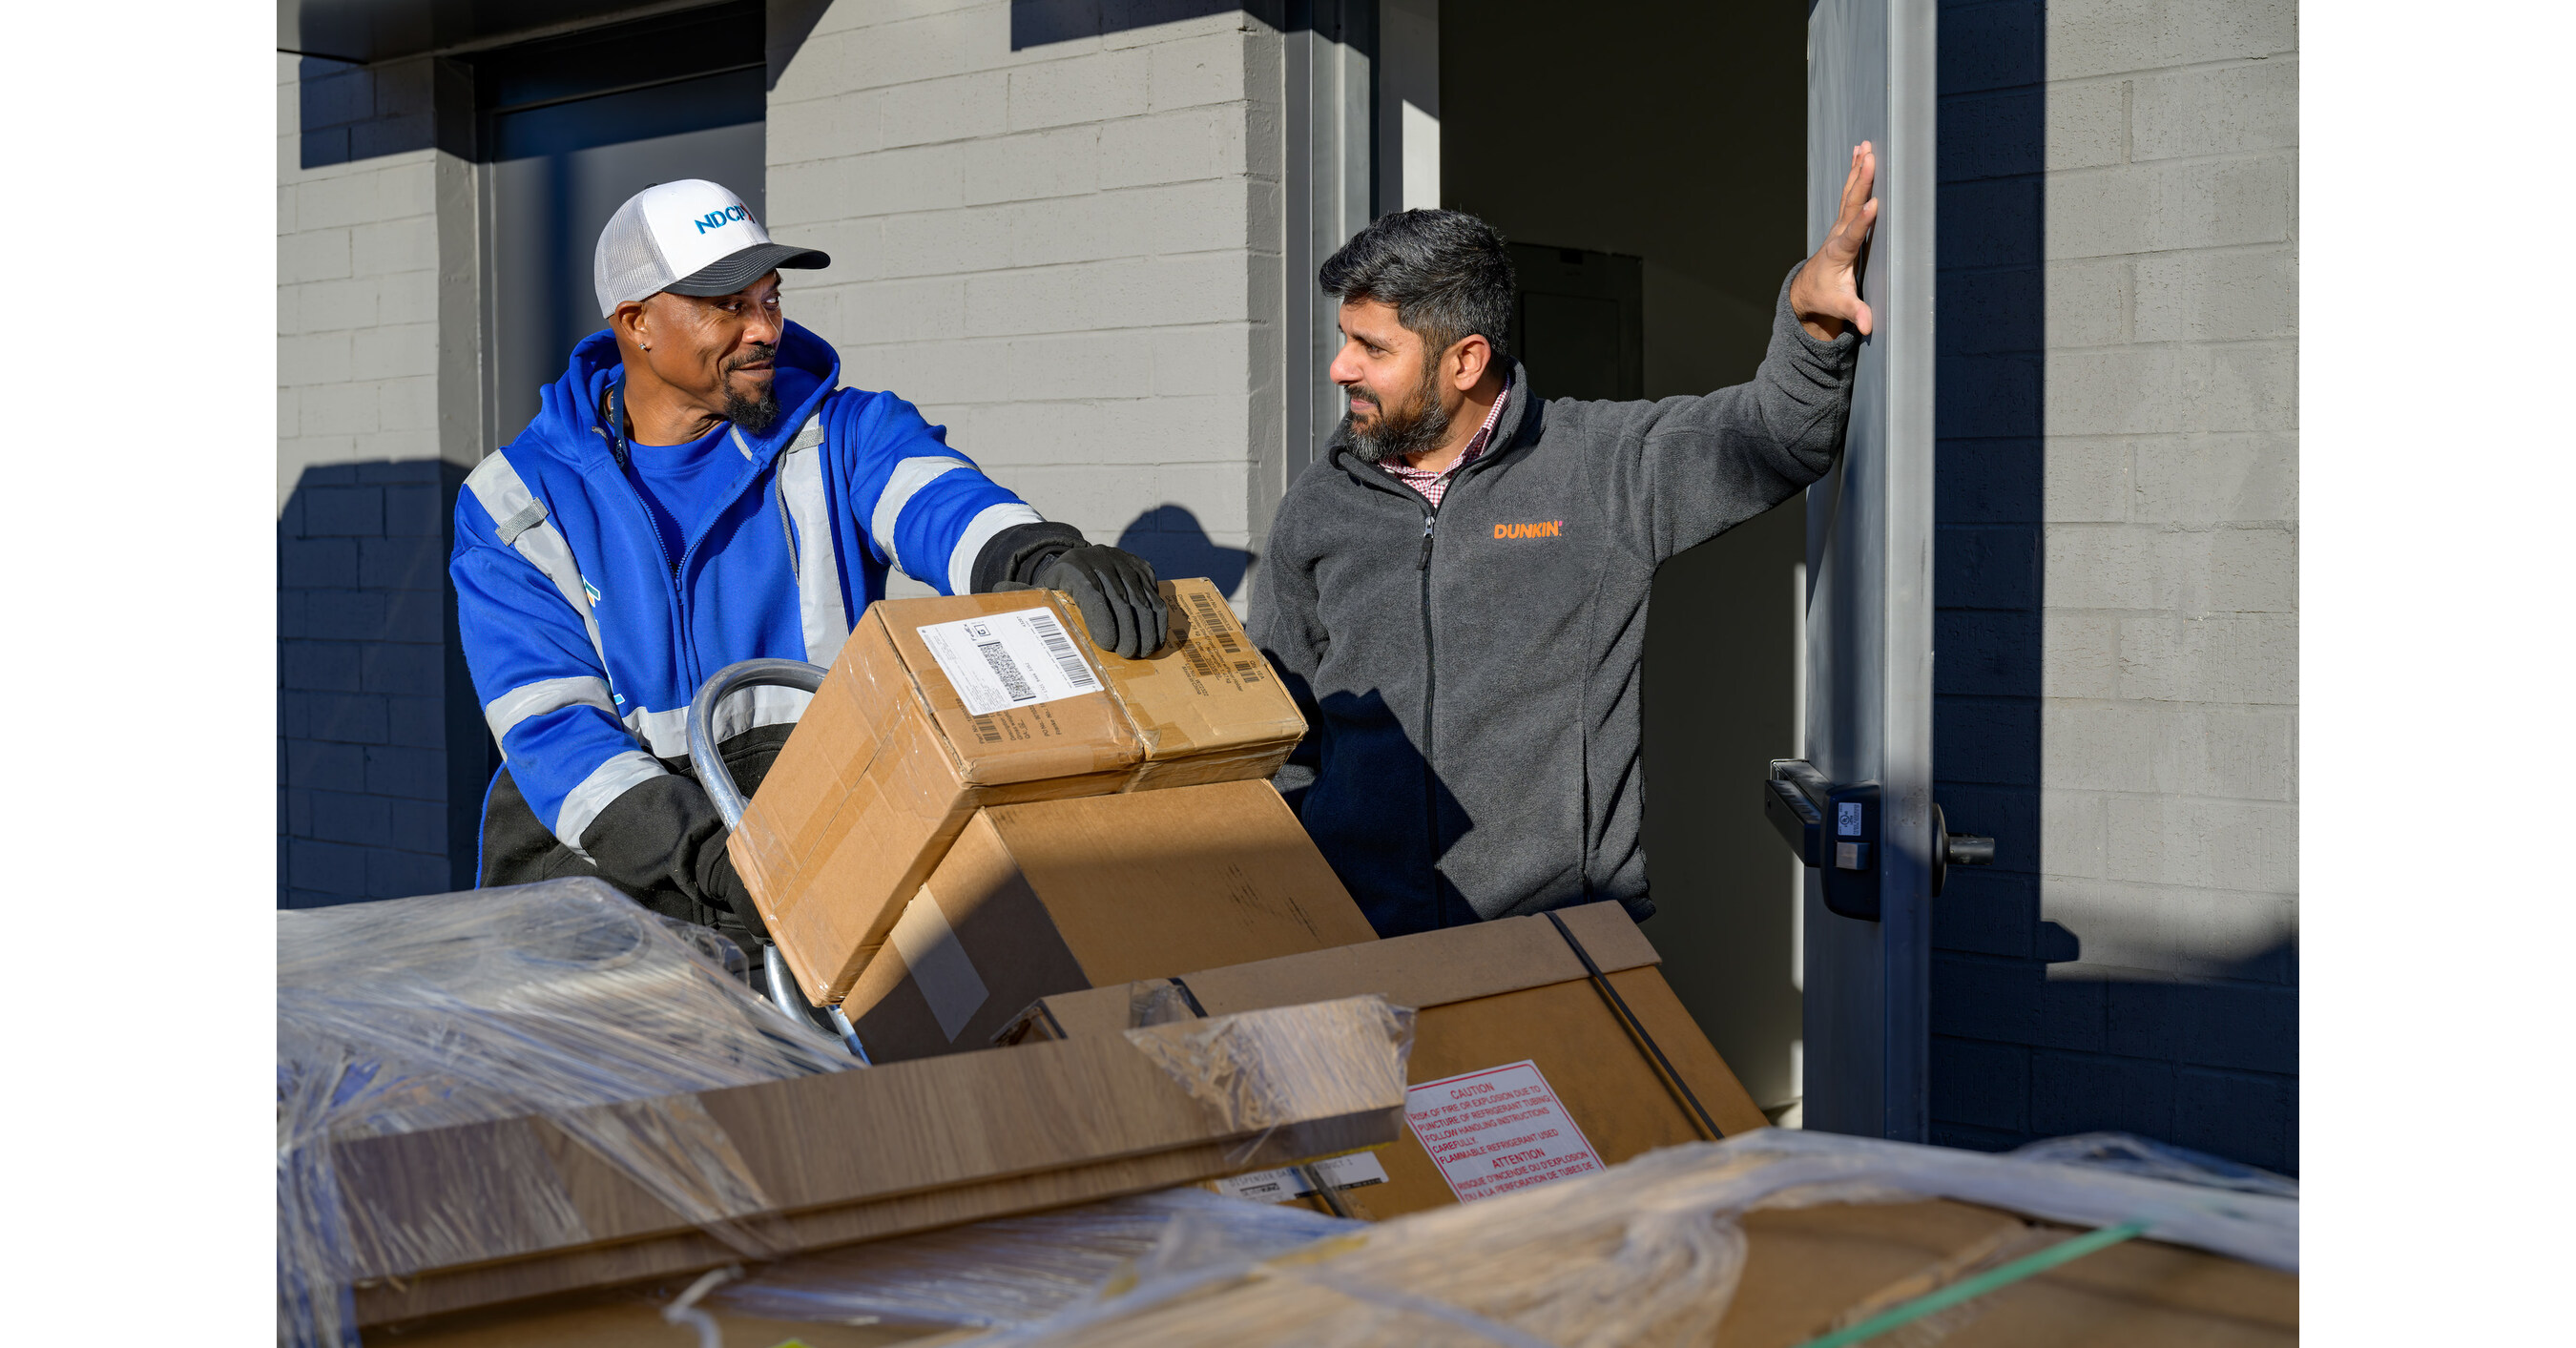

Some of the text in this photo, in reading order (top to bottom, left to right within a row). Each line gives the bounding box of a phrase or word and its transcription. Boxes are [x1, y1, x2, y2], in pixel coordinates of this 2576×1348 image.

[1410, 1086, 1541, 1121] RISK OF FIRE OR EXPLOSION DUE TO
[1450, 1083, 1495, 1099] CAUTION
[1417, 1116, 1461, 1132] PUNCTURE
[1461, 1112, 1471, 1123] OF
[1472, 1101, 1522, 1120] REFRIGERANT
[1423, 1107, 1550, 1144] FOLLOW HANDLING INSTRUCTIONS
[1432, 1136, 1478, 1153] CAREFULLY.
[1439, 1129, 1559, 1165] FLAMMABLE REFRIGERANT USED
[1492, 1148, 1546, 1169] ATTENTION
[1456, 1151, 1589, 1192] RISQUE D'INCENDIE OU D'EXPLOSION
[1485, 1187, 1495, 1196] LA
[1495, 1174, 1547, 1192] PERFORATION
[1548, 1169, 1558, 1180] DE
[1557, 1164, 1583, 1176] TUBES
[1580, 1161, 1594, 1171] DE
